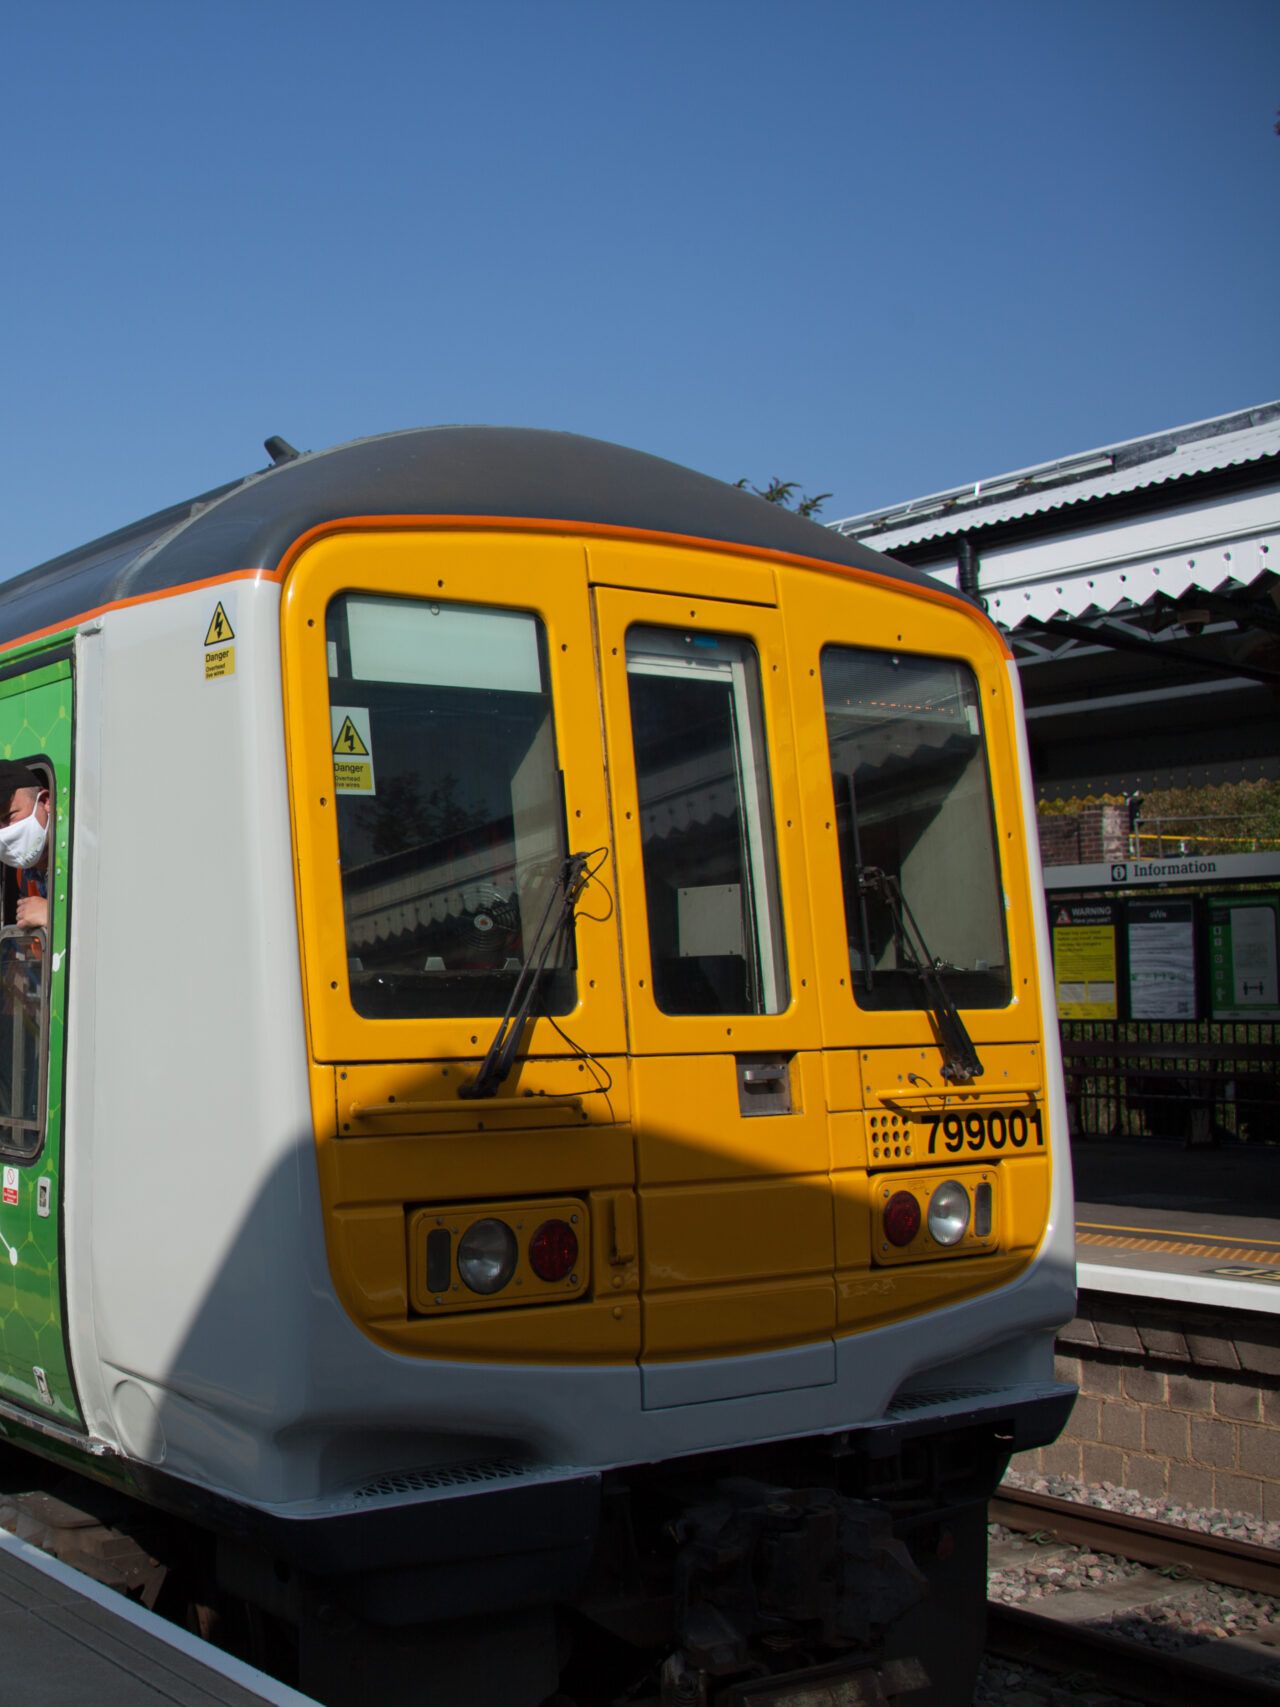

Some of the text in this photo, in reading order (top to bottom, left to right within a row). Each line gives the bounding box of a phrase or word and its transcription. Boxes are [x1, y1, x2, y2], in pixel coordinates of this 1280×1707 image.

[205, 650, 229, 662] Danger
[334, 763, 364, 773] Danger
[1134, 861, 1217, 877] Information
[1072, 906, 1112, 917] WARNING
[921, 1108, 1045, 1154] 799001
